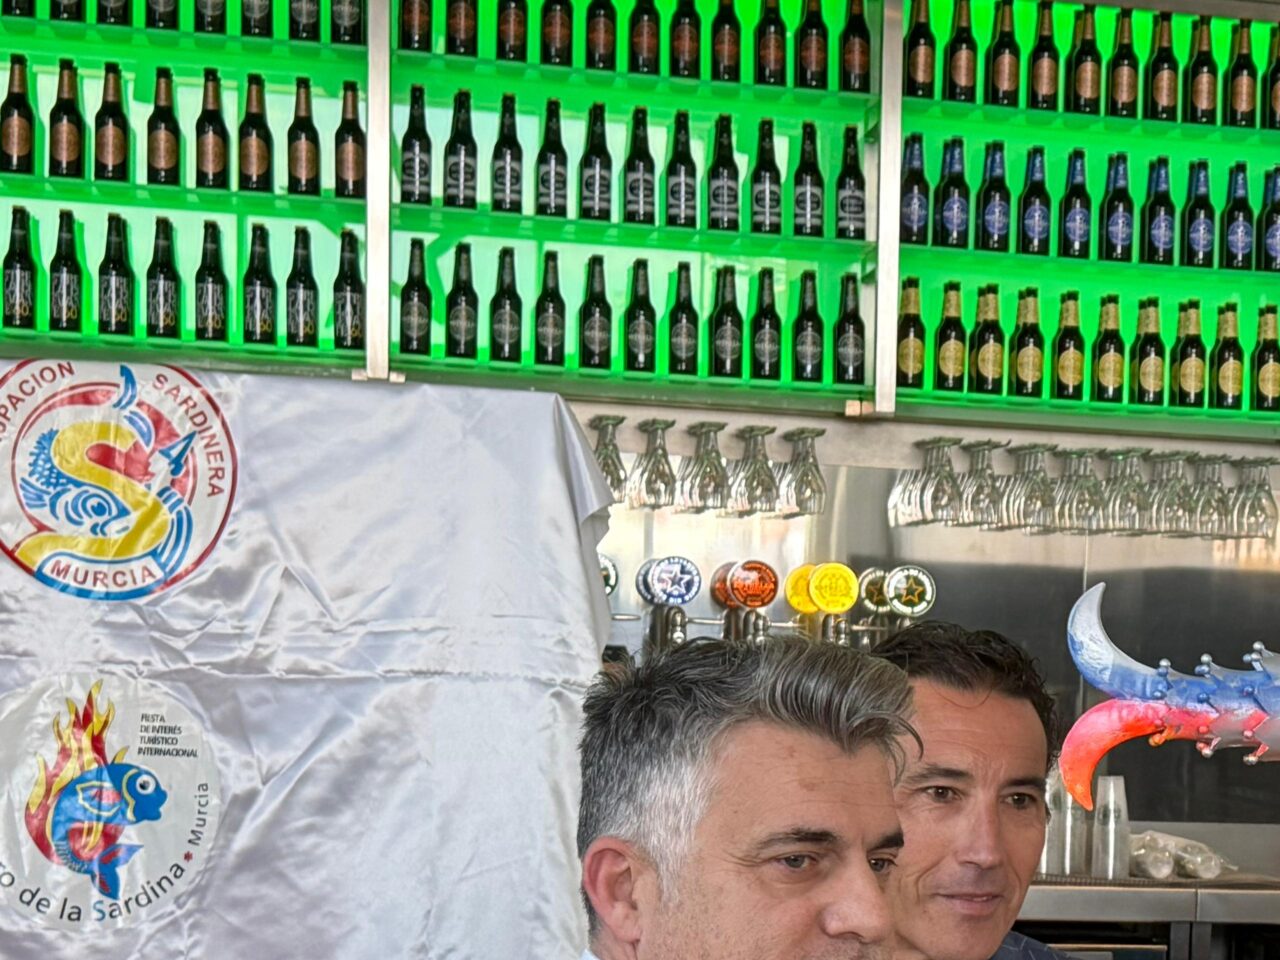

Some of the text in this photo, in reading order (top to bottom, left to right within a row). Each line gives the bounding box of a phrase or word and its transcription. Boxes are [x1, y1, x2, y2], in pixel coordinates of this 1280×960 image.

[152, 373, 225, 498] SARDINERA
[50, 559, 157, 588] MURCIA
[140, 713, 166, 723] FIESTA
[140, 724, 149, 734] DE
[137, 746, 199, 758] INTERNACIONAL
[19, 886, 51, 915] de
[59, 897, 82, 922] la
[93, 862, 186, 922] Sardina
[188, 782, 209, 847] Murcia
